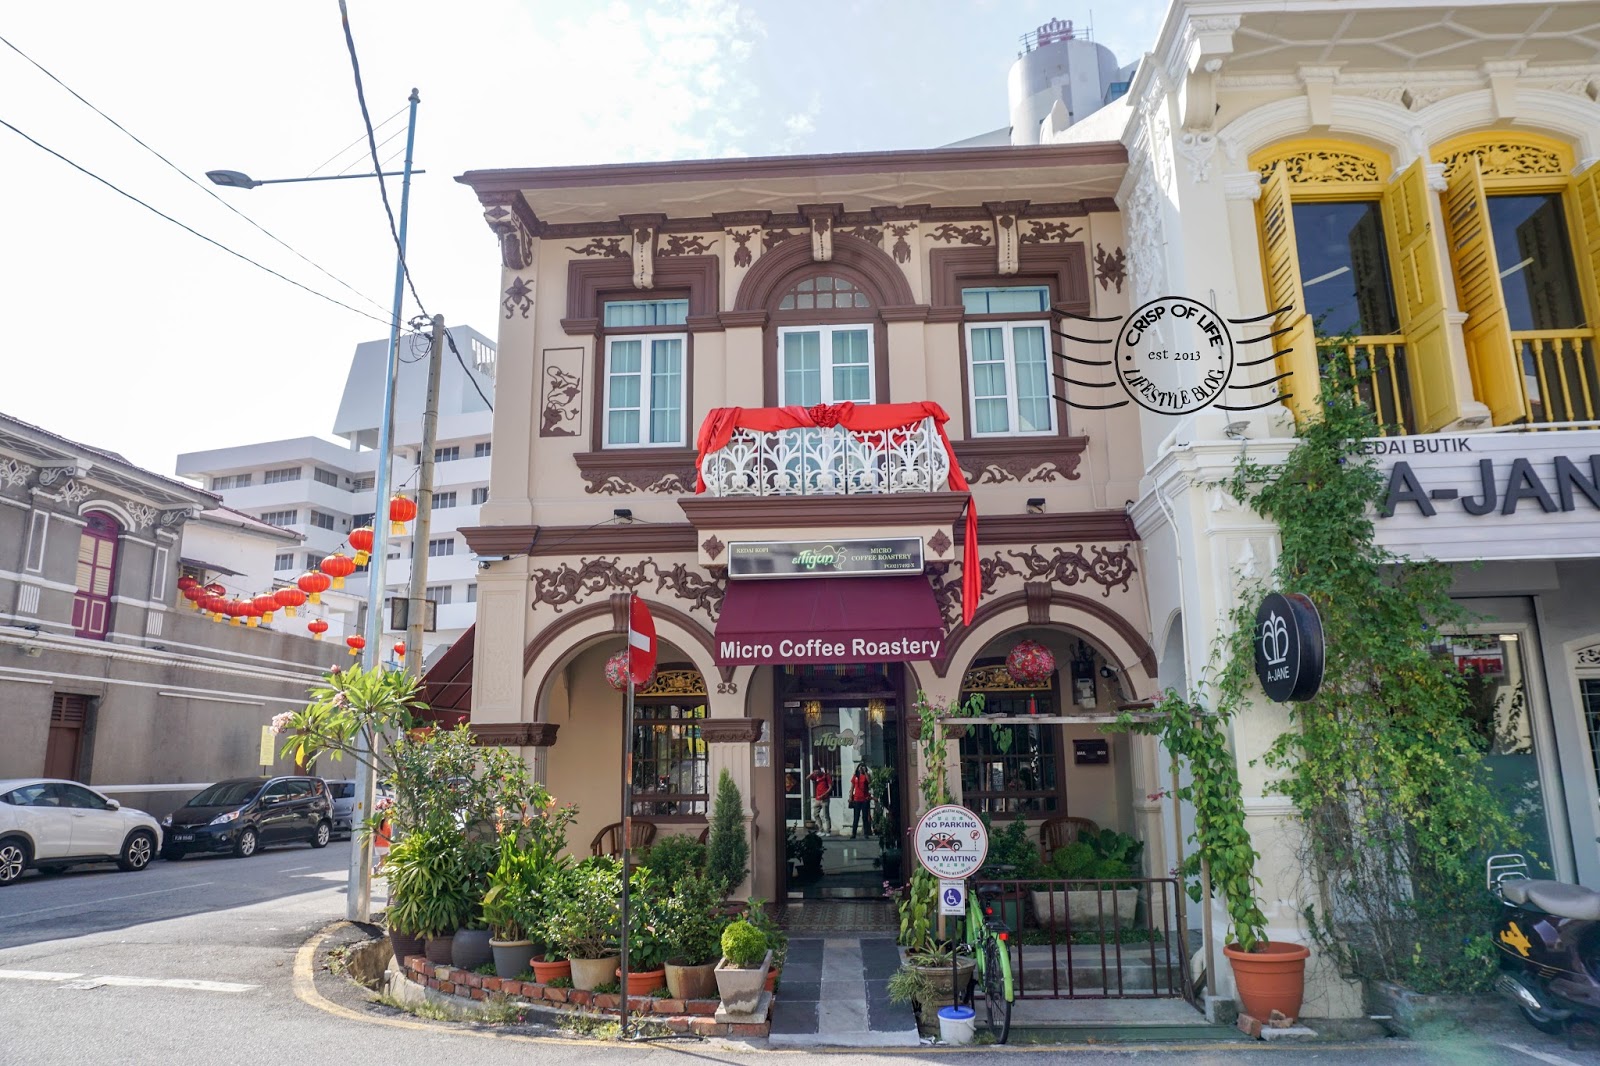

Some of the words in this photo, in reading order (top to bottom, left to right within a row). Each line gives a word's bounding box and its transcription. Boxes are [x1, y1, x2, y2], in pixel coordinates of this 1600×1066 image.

[1413, 437, 1472, 454] BUTIK
[877, 553, 912, 561] ROASTERY
[720, 640, 774, 659] Micro
[779, 639, 846, 658] Coffee
[852, 637, 941, 658] Roastery
[1267, 666, 1290, 683] A-JANE
[716, 682, 738, 695] 28
[940, 821, 977, 829] PARKING
[941, 855, 977, 863] WAITING
